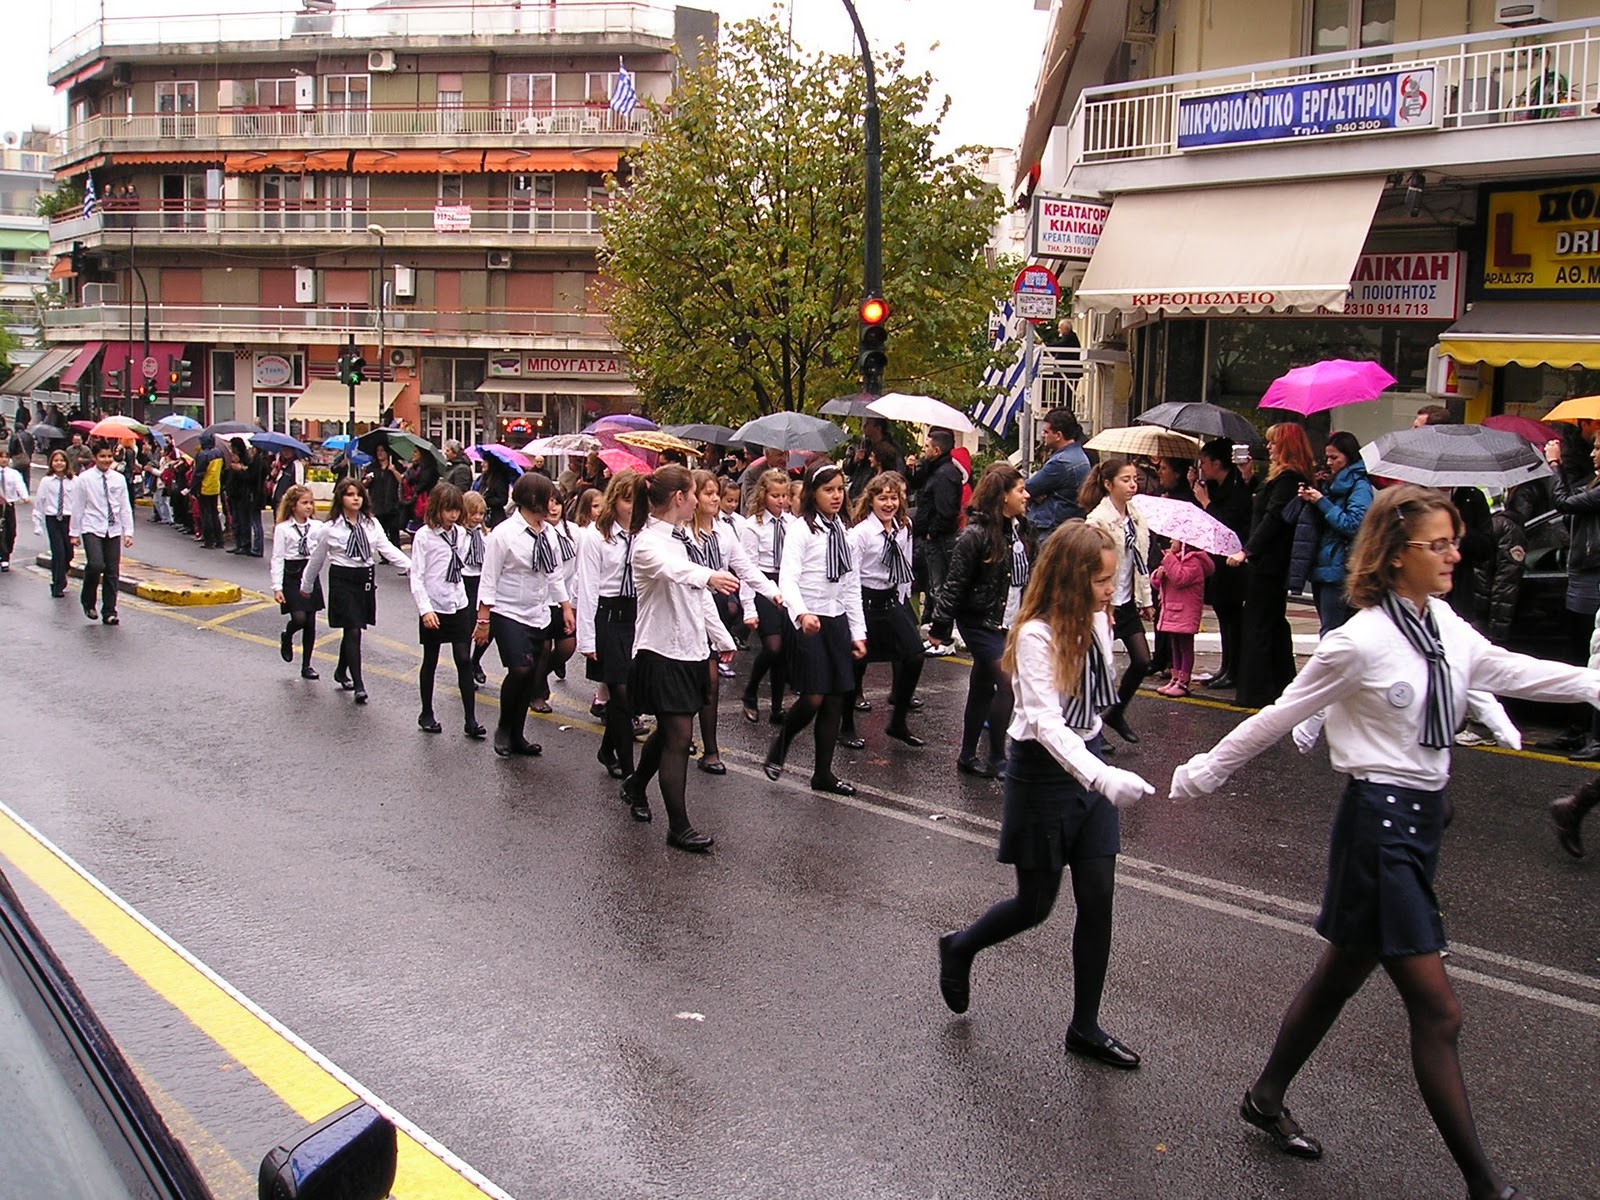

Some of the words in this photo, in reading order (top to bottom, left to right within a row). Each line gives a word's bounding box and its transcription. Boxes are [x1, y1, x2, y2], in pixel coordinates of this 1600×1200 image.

[1179, 91, 1294, 137] ΜΙΚΡΟΒΙΟΛΟΓΙΚΟ
[1301, 80, 1393, 124] ΕΡΓΑΣΤΗΡΙΟ
[1132, 291, 1275, 307] ΚΡΕΟΠΩΛΕΙΟ
[1362, 284, 1437, 300] ΠΟΙΟΤΗΤΟΣ
[1343, 303, 1374, 315] 2310
[1377, 303, 1400, 315] 914
[1404, 303, 1428, 315] 713
[527, 358, 617, 372] ΜΠΟΥΓΑΤΣΑ
